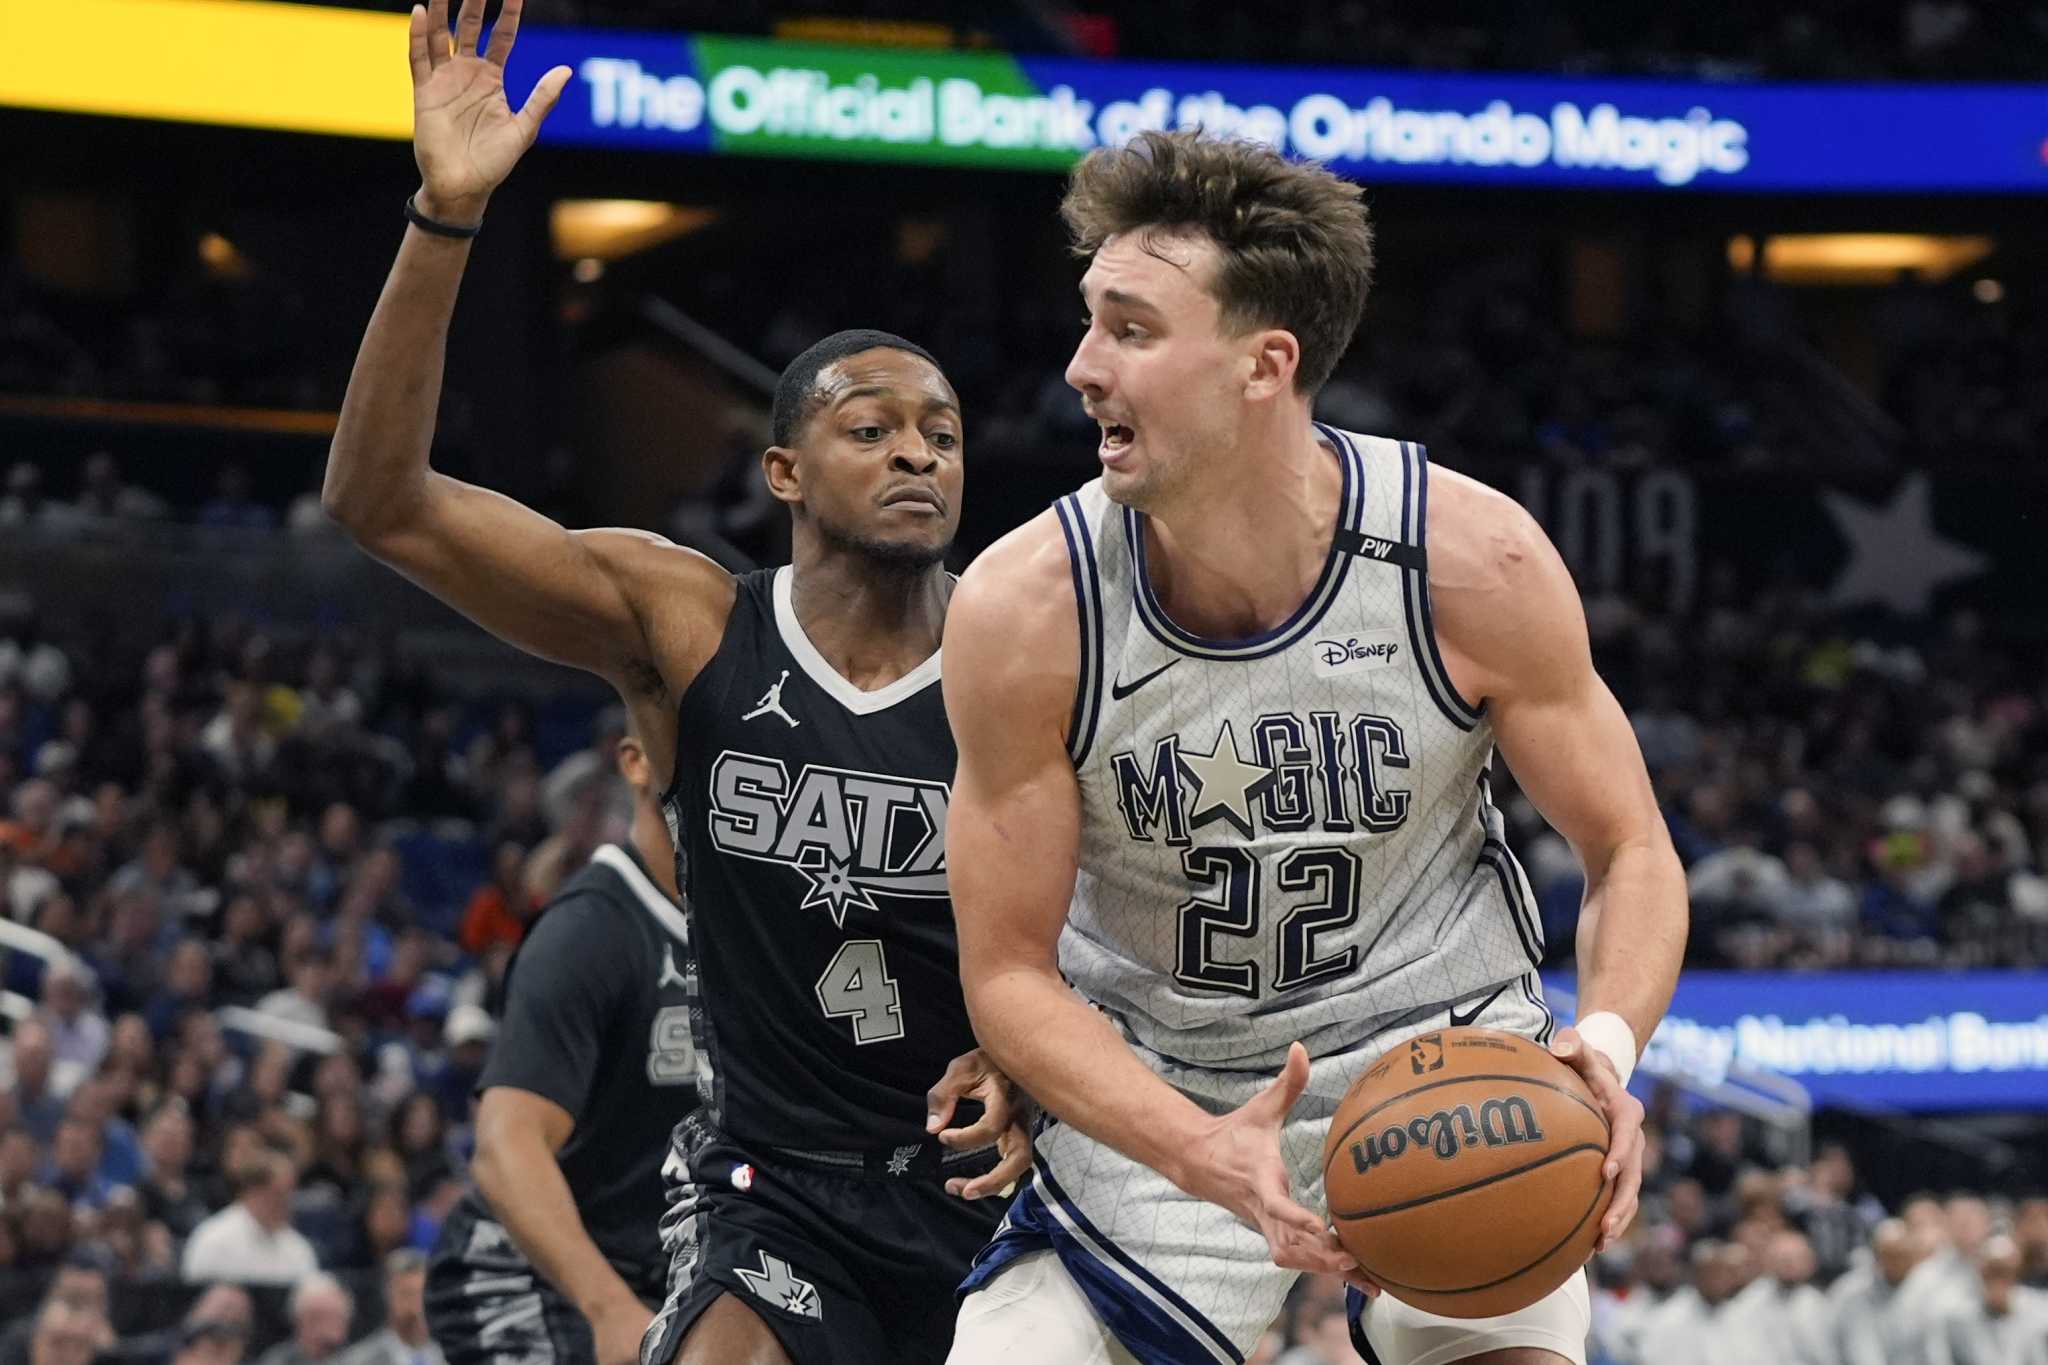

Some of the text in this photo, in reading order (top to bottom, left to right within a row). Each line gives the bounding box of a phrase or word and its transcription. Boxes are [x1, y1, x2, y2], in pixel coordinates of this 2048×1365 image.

[580, 57, 703, 131] The
[707, 65, 935, 145] Official
[937, 79, 1096, 151] Bank
[1097, 88, 1174, 148] of
[1288, 93, 1550, 168] Orlando
[1552, 101, 1748, 185] Magic
[1360, 538, 1392, 559] PW
[1173, 845, 1363, 999] 22
[815, 939, 905, 1046] 4
[1736, 1013, 1947, 1075] National
[1351, 1094, 1545, 1175] Wilson
